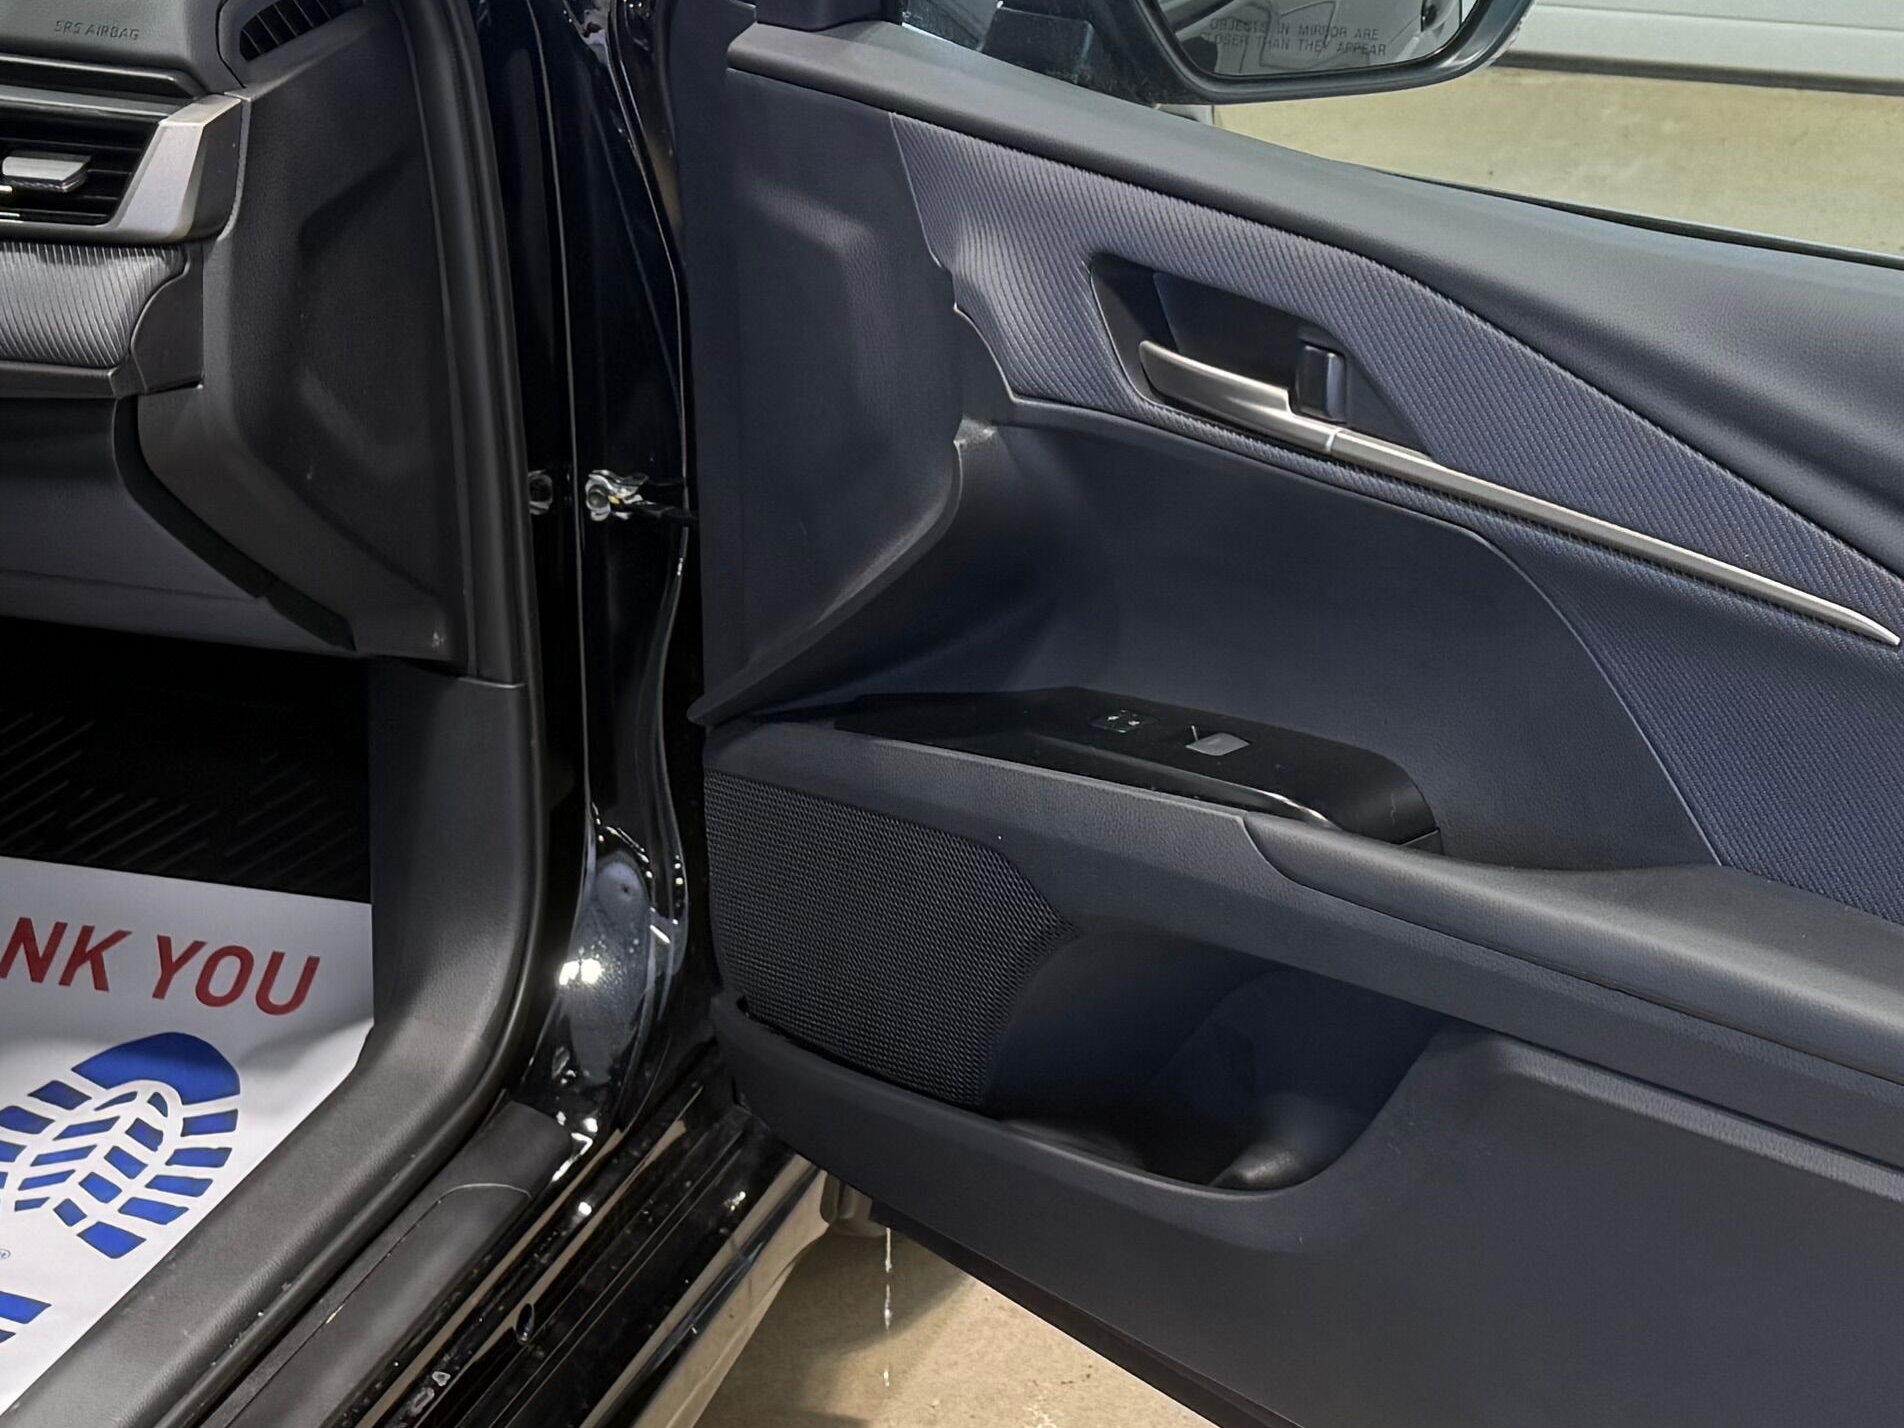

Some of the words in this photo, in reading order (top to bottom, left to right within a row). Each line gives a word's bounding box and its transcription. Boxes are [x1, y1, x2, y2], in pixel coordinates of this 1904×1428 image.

[53, 20, 84, 34] SRS
[85, 23, 140, 41] AIRBAG
[1209, 18, 1266, 33] OBJECTS
[1276, 22, 1290, 35] IN
[1297, 24, 1348, 39] MIRROR
[1354, 27, 1380, 40] ARE
[1255, 35, 1290, 50] THAN
[1297, 38, 1327, 52] THEY
[1336, 41, 1387, 56] APPEAR
[152, 934, 321, 1017] YOU
